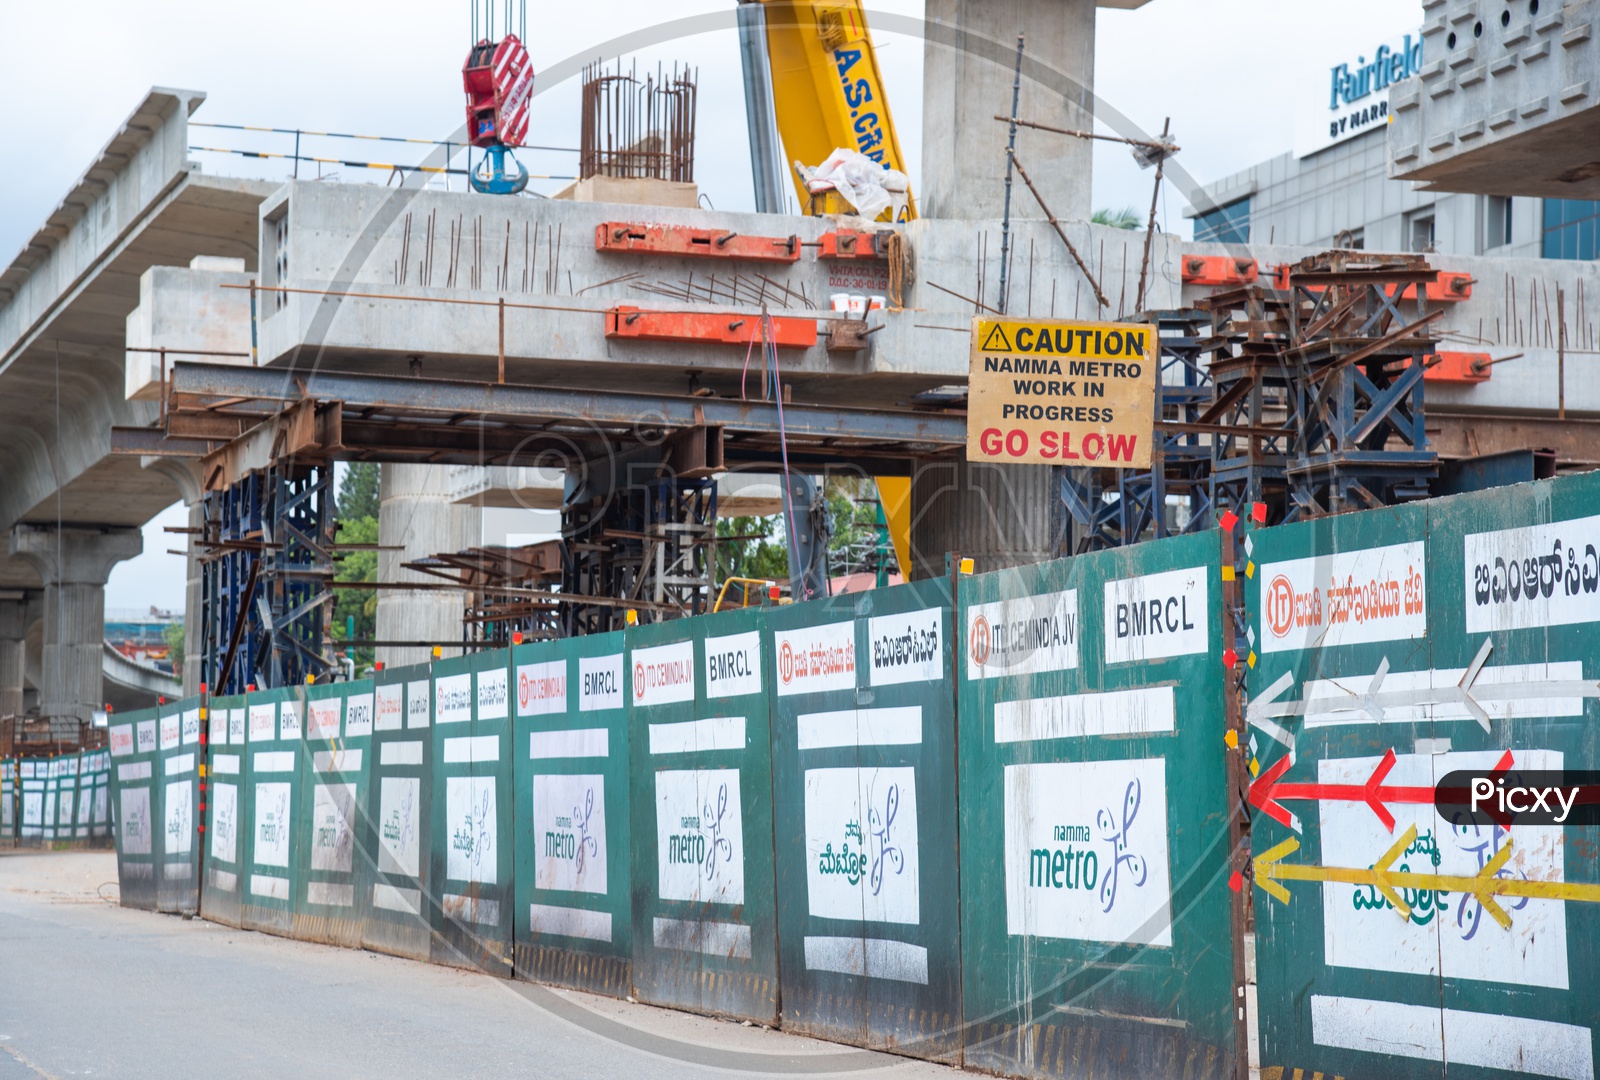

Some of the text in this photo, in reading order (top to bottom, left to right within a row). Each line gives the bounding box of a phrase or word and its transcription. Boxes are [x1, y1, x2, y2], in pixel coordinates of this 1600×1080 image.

[1329, 28, 1424, 111] Fairfield
[1330, 101, 1387, 137] BY MARR
[1015, 327, 1144, 356] CAUTION
[984, 357, 1142, 378] NAMMA METRO
[1014, 380, 1105, 397] WORK IN
[1002, 404, 1114, 423] PROGRESS
[980, 427, 1137, 462] GO SLOW
[1116, 595, 1194, 638] BMRCL
[1010, 615, 1061, 652] CEMINDIA
[1063, 613, 1075, 645] JV
[647, 659, 692, 687] ITD CEMINDIA JV
[710, 650, 752, 681] BMRCL
[584, 670, 617, 695] BMRCL
[348, 705, 369, 724] BMRCL
[317, 826, 336, 848] metro
[681, 816, 700, 829] namma
[1054, 825, 1090, 842] namma
[545, 829, 574, 860] metro
[669, 830, 705, 864] metro
[1030, 844, 1098, 890] metro
